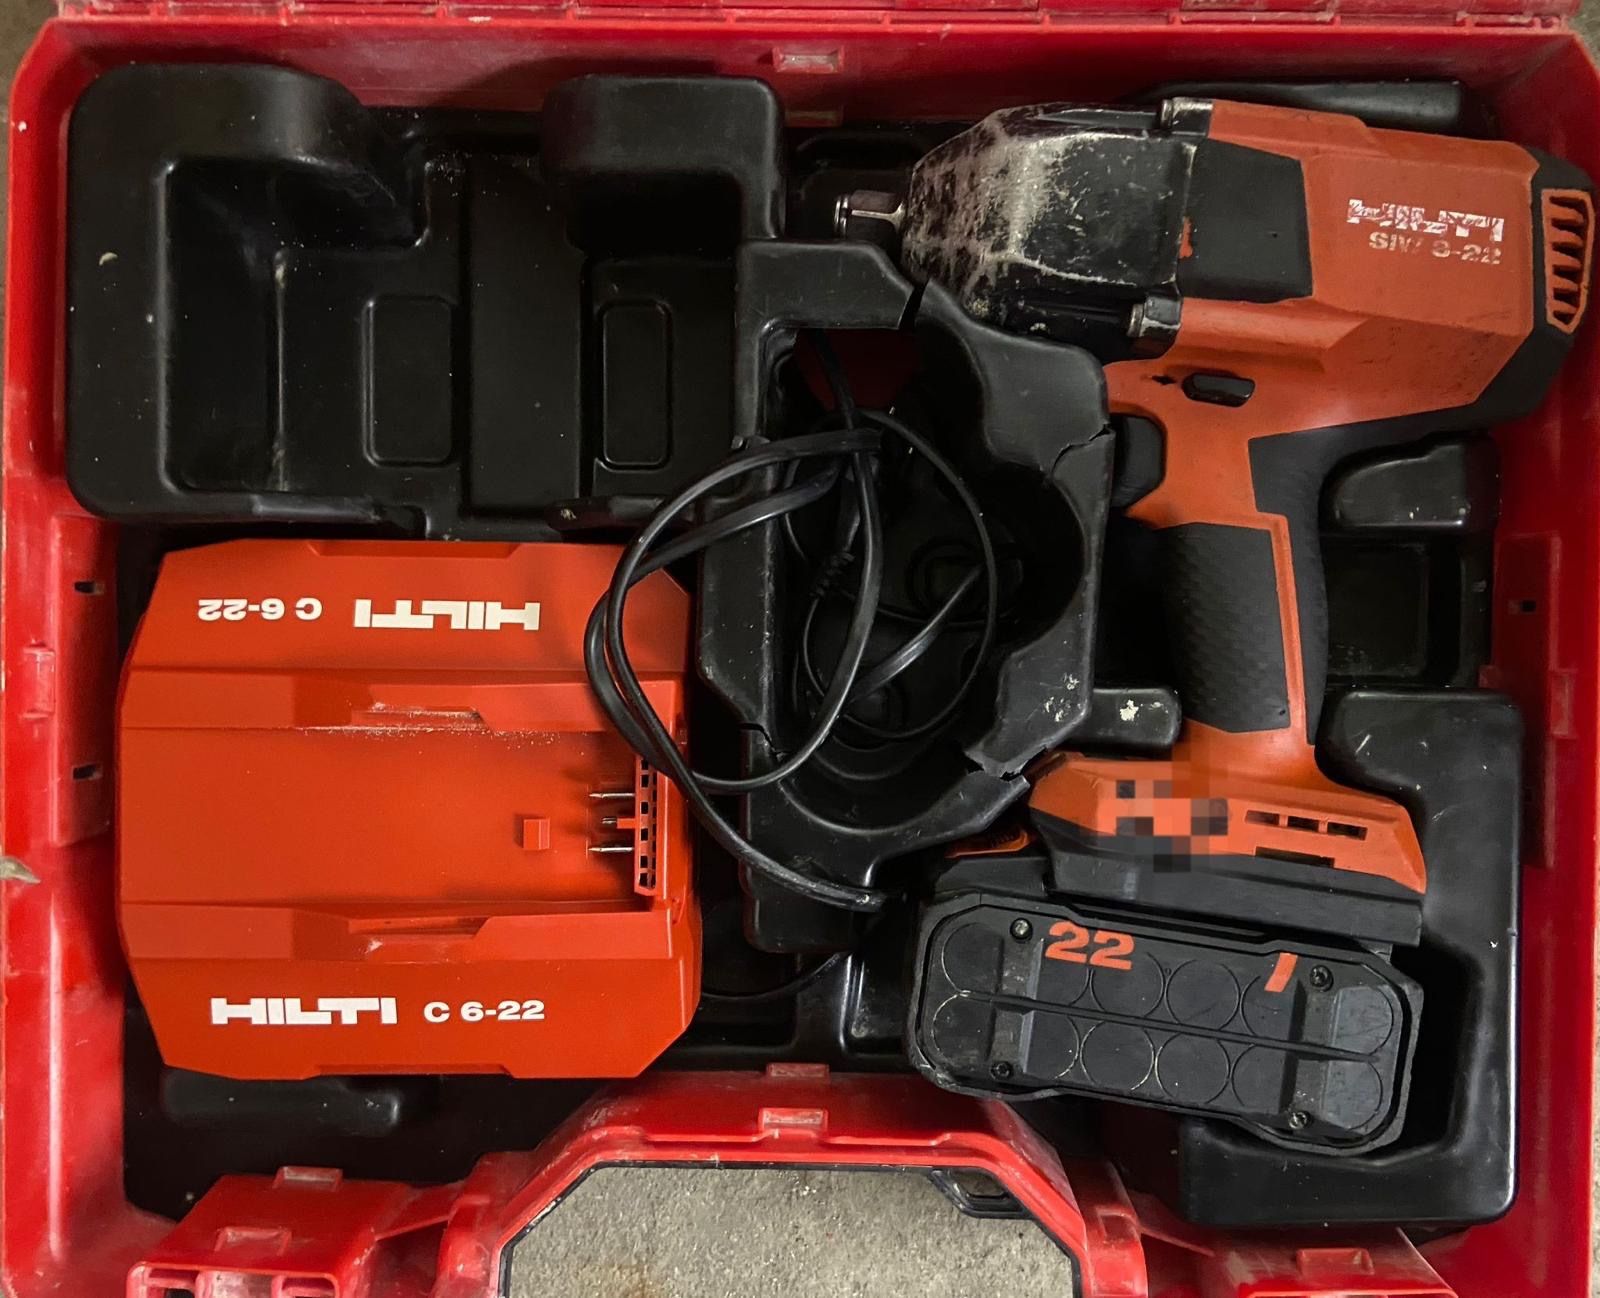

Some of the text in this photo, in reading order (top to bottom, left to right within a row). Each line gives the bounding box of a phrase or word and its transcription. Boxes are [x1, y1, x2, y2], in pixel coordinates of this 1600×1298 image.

[1347, 199, 1504, 241] HILTI
[198, 598, 541, 630] HILTI C 6-22
[1045, 921, 1134, 970] 22
[210, 997, 545, 1025] HILTI C 6-22
